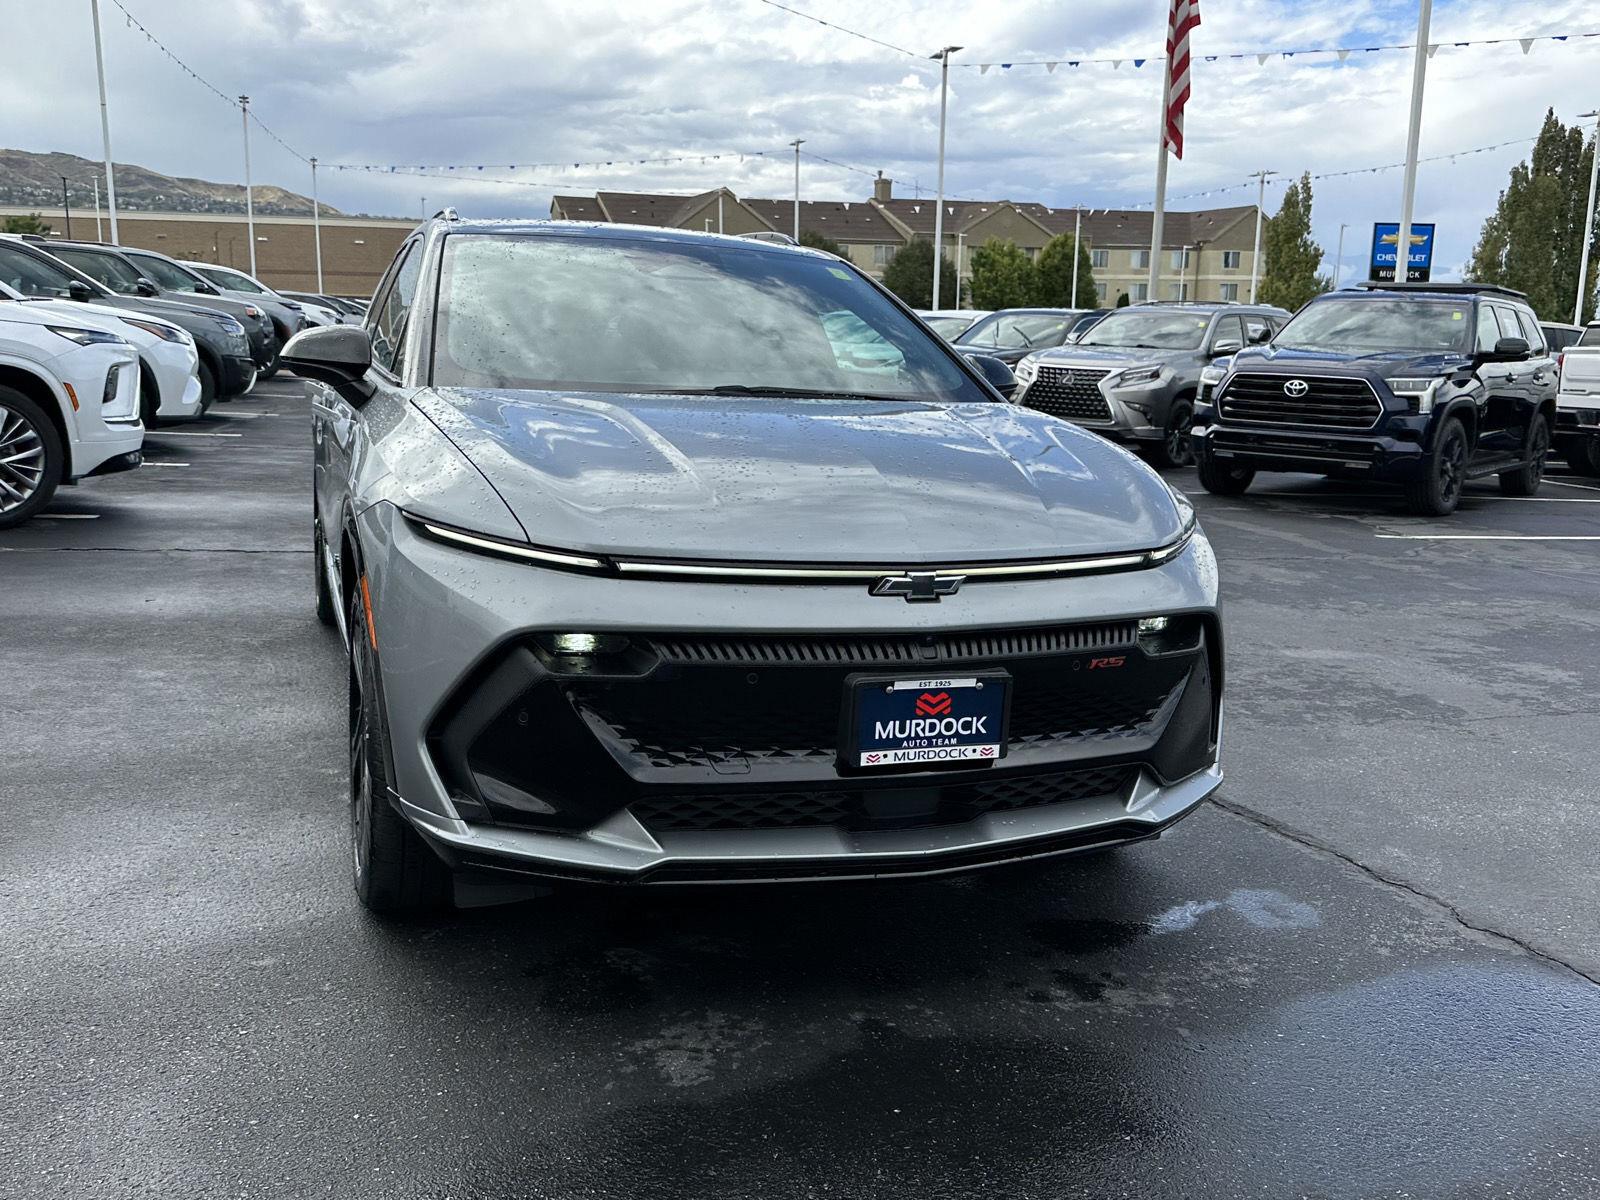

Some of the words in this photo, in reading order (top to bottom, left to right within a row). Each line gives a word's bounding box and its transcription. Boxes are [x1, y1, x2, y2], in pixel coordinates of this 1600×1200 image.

[1088, 655, 1127, 670] RS
[874, 716, 988, 740] MURDOCK
[902, 739, 928, 747] AUTO
[931, 738, 958, 746] TEAM
[893, 748, 969, 762] MURDOCK
